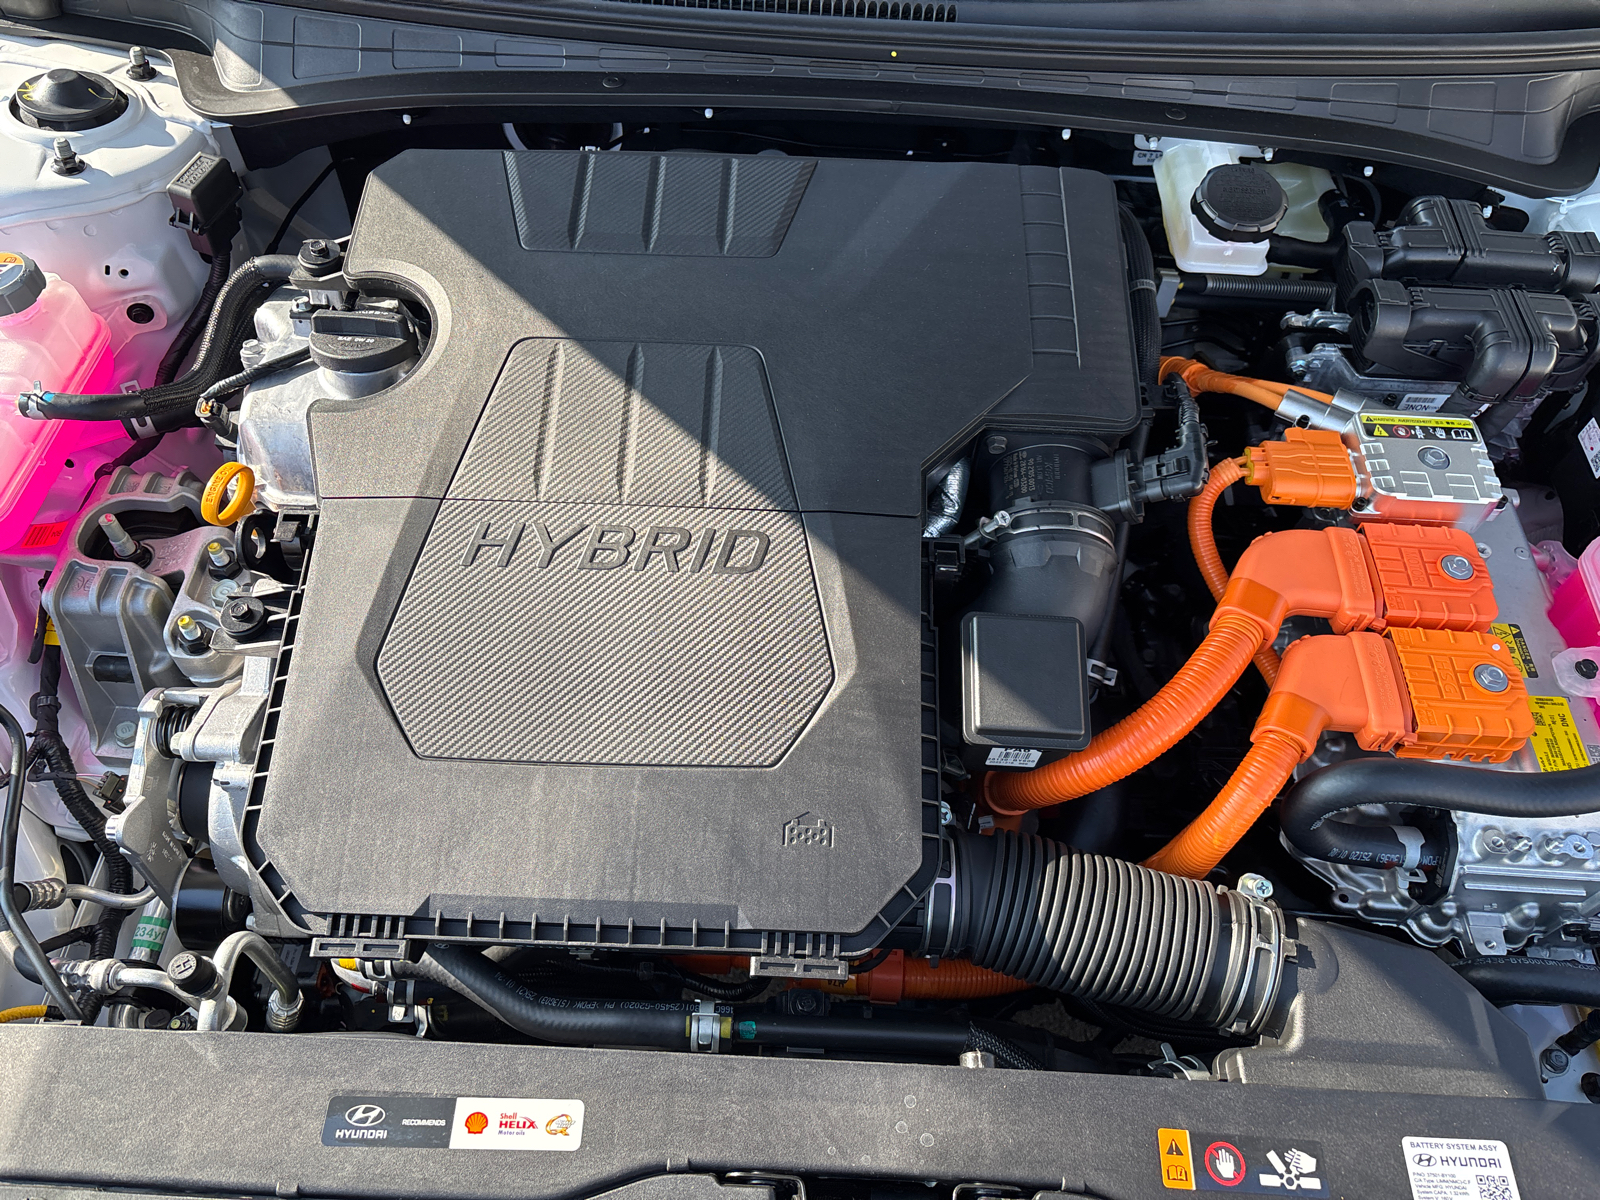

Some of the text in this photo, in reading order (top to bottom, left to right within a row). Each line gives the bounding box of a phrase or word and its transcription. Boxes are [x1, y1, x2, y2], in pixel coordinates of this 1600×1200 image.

[1403, 403, 1429, 411] NONE
[459, 521, 771, 575] HYBRID
[1406, 551, 1426, 583] MOTOR
[1436, 659, 1459, 694] HSG
[1558, 713, 1569, 727] DNC
[134, 926, 166, 941] 234yf
[603, 1001, 616, 1009] PH
[498, 1120, 538, 1129] HELIX
[335, 1129, 388, 1139] HYUNDAI
[1410, 1141, 1444, 1150] BATTERY
[1446, 1142, 1476, 1150] SYSTEM
[1440, 1156, 1502, 1168] HYUNDAI
